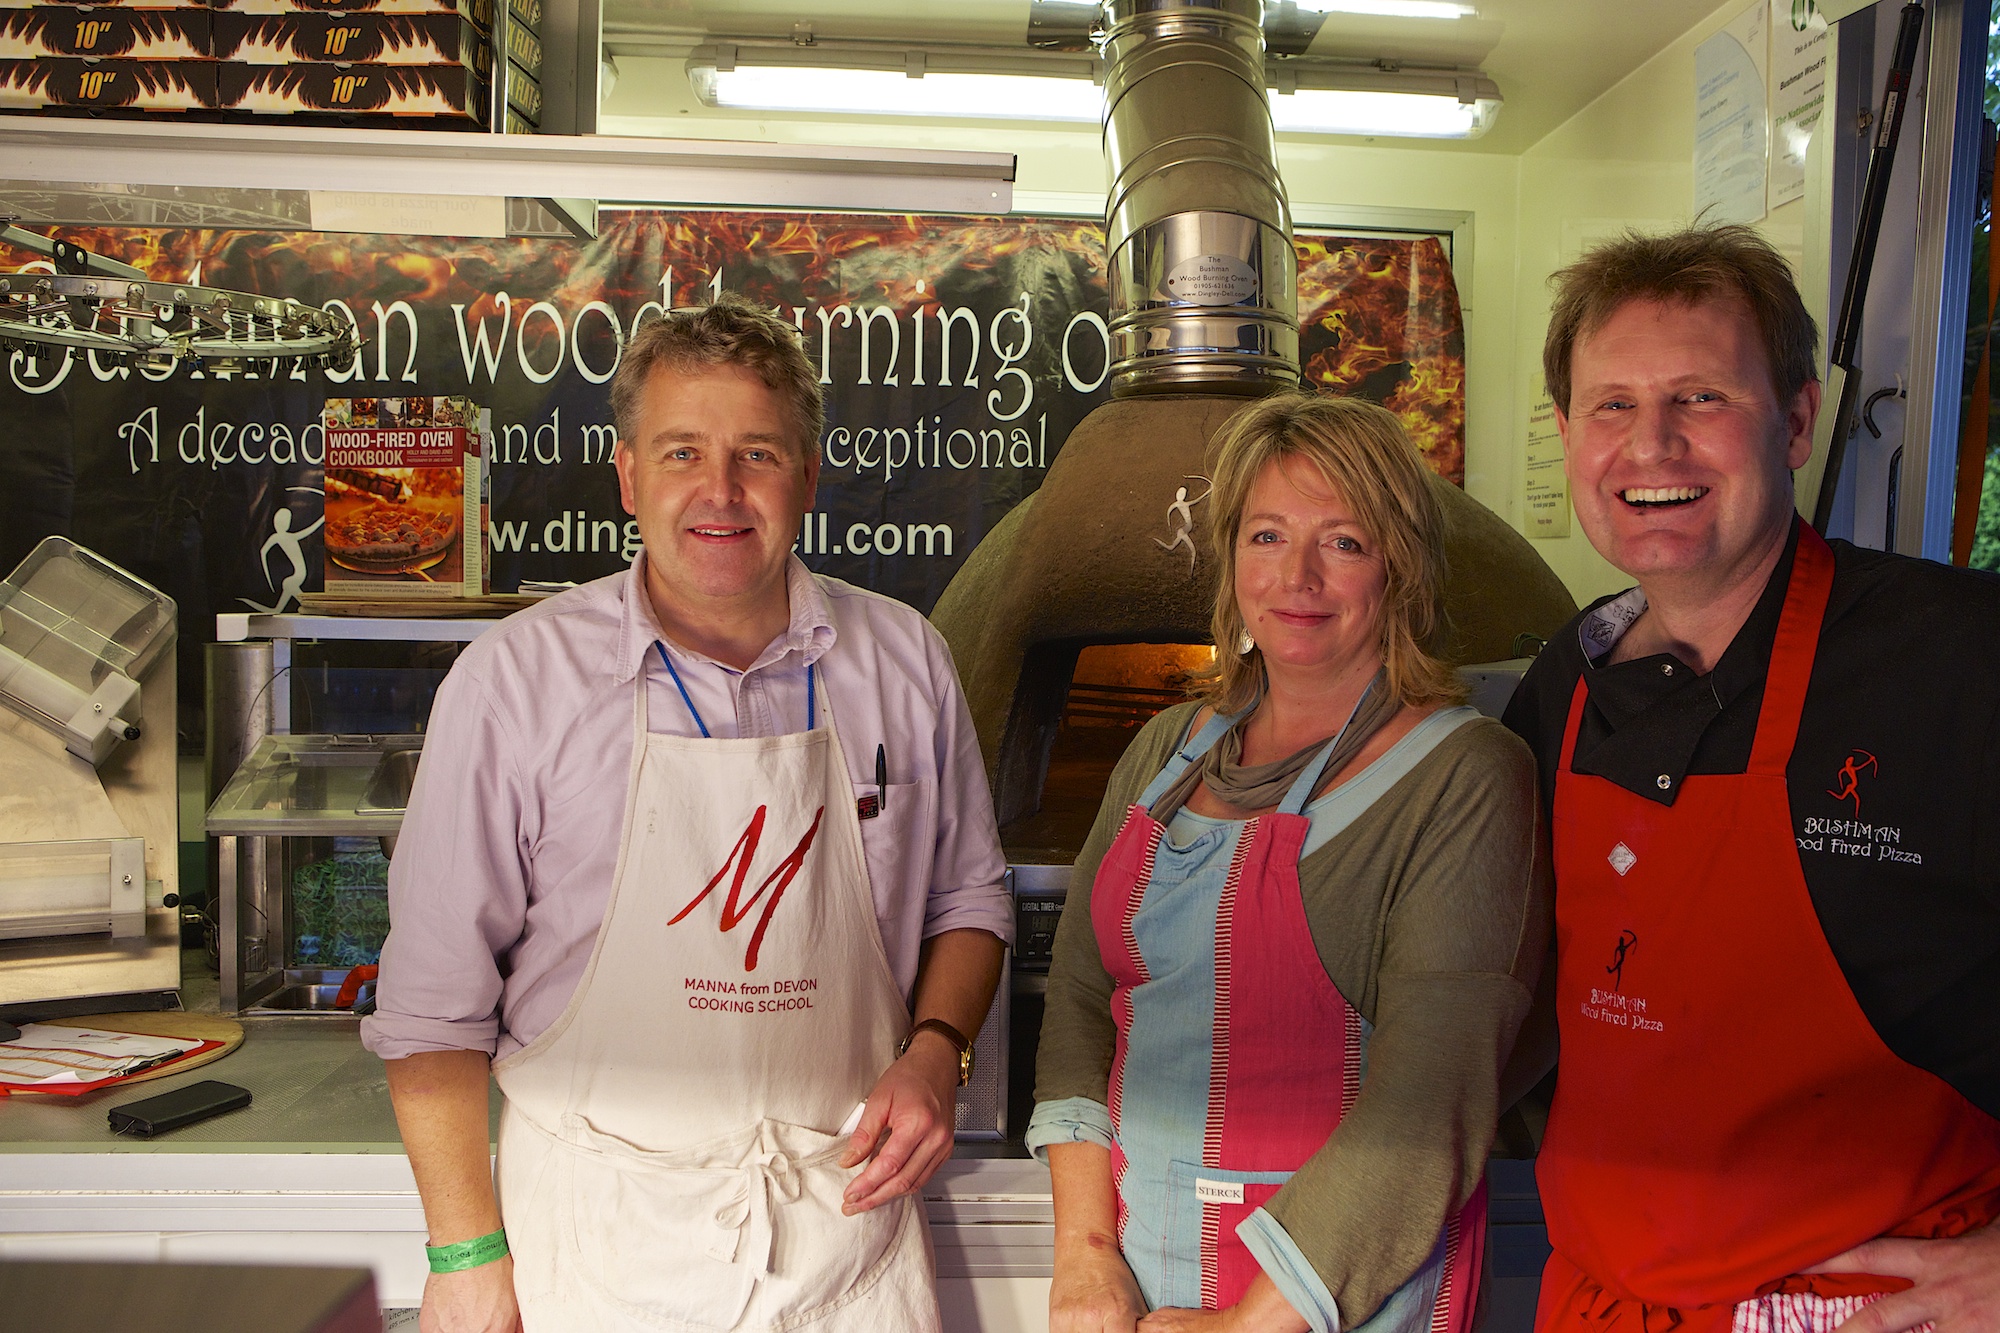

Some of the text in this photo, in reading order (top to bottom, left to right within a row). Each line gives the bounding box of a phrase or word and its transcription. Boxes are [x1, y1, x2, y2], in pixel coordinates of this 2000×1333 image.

[74, 20, 113, 49] 10"
[323, 27, 361, 55] 10"
[78, 71, 117, 99] 10"
[330, 75, 368, 103] 10"
[1203, 274, 1229, 282] Burning
[1231, 274, 1248, 282] Oven
[118, 406, 160, 474] A
[178, 405, 326, 471] decad
[820, 411, 1047, 484] ceptional
[329, 431, 416, 449] WOOD-FIRED
[419, 430, 454, 447] OVEN
[329, 449, 404, 466] COOKBOOK
[1804, 817, 1900, 843] BUSHMAN
[1796, 837, 1922, 865] ood Fired Pizza
[1021, 902, 1040, 912] DIGITAL
[1040, 902, 1055, 912] TIMER
[684, 978, 817, 995] MANNA from DEVON
[688, 996, 813, 1013] COOKING SCHOOL
[1590, 988, 1646, 1013] BUSHMAN
[1601, 1008, 1627, 1026] Fired
[1632, 1015, 1663, 1032] Pizza
[1198, 1186, 1241, 1198] STERCK
